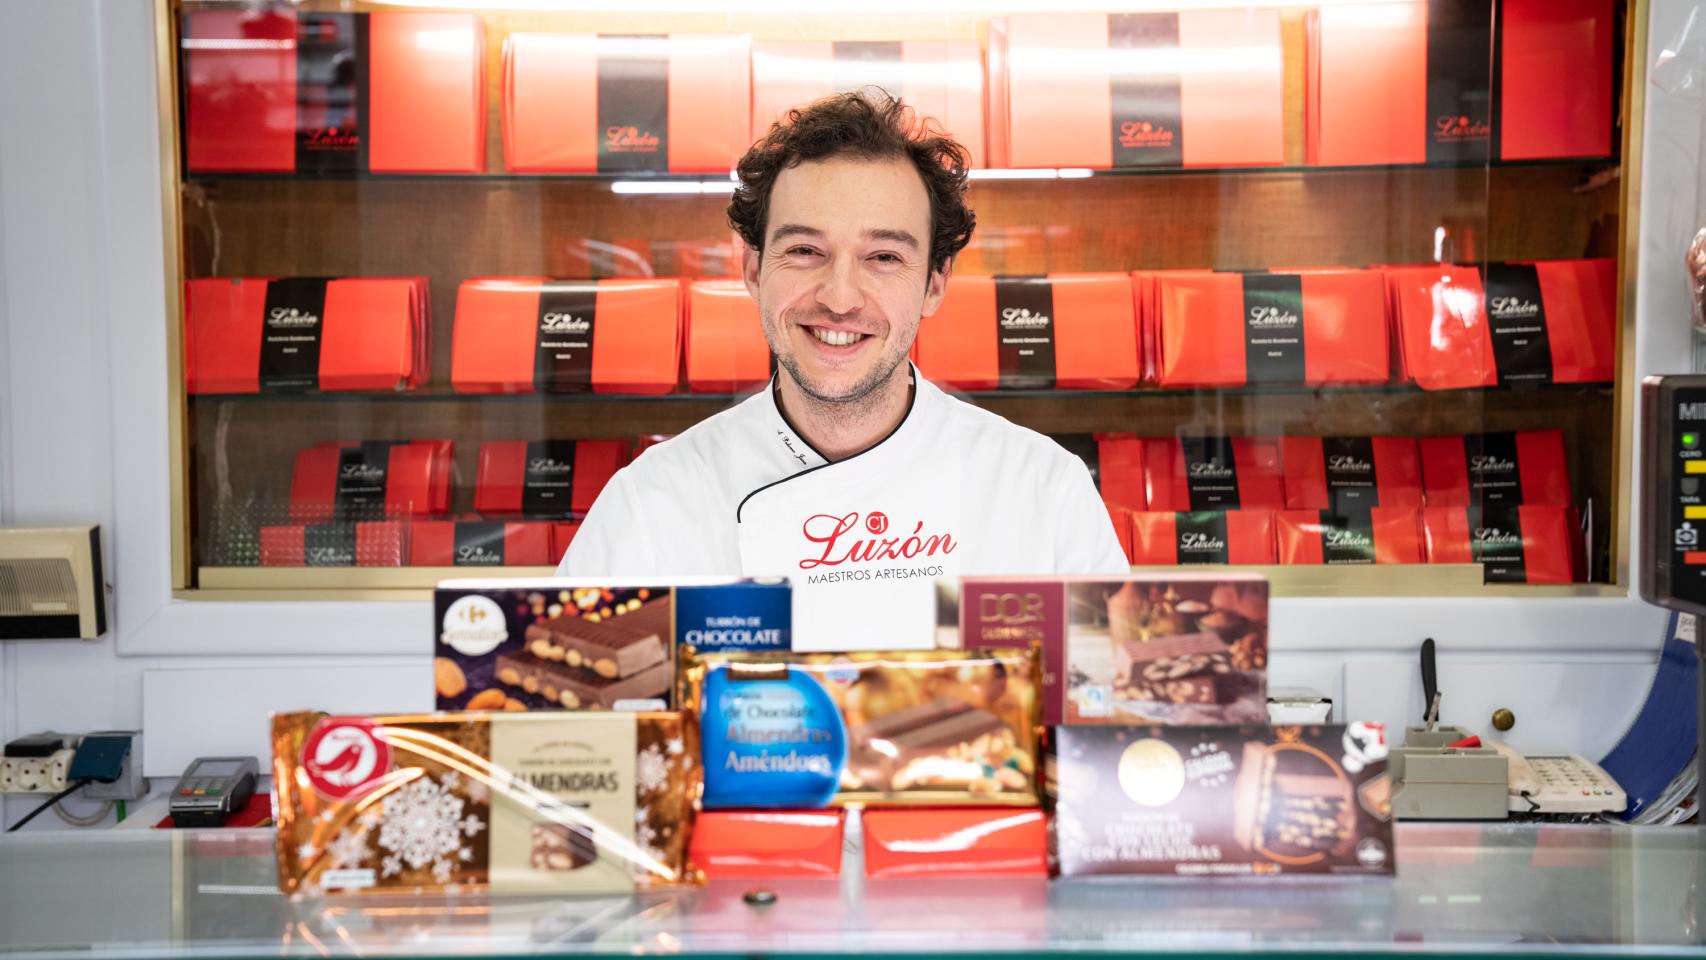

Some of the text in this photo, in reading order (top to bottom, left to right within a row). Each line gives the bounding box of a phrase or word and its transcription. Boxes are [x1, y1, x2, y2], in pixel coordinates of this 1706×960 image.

[605, 126, 660, 147] Luzón
[1119, 121, 1174, 143] Luzón
[1490, 296, 1539, 315] Luzón
[267, 307, 318, 325] Luzón
[541, 312, 590, 330] Luzón
[1001, 308, 1049, 325] Luzón
[1249, 306, 1298, 325] Luzón
[866, 514, 887, 533] CJ
[799, 511, 957, 569] Luzón
[1180, 532, 1225, 549] Luzón
[808, 565, 944, 585] MAESTROS ARTESANOS
[685, 629, 780, 646] CHOCOLATE
[725, 723, 832, 743] Almendras
